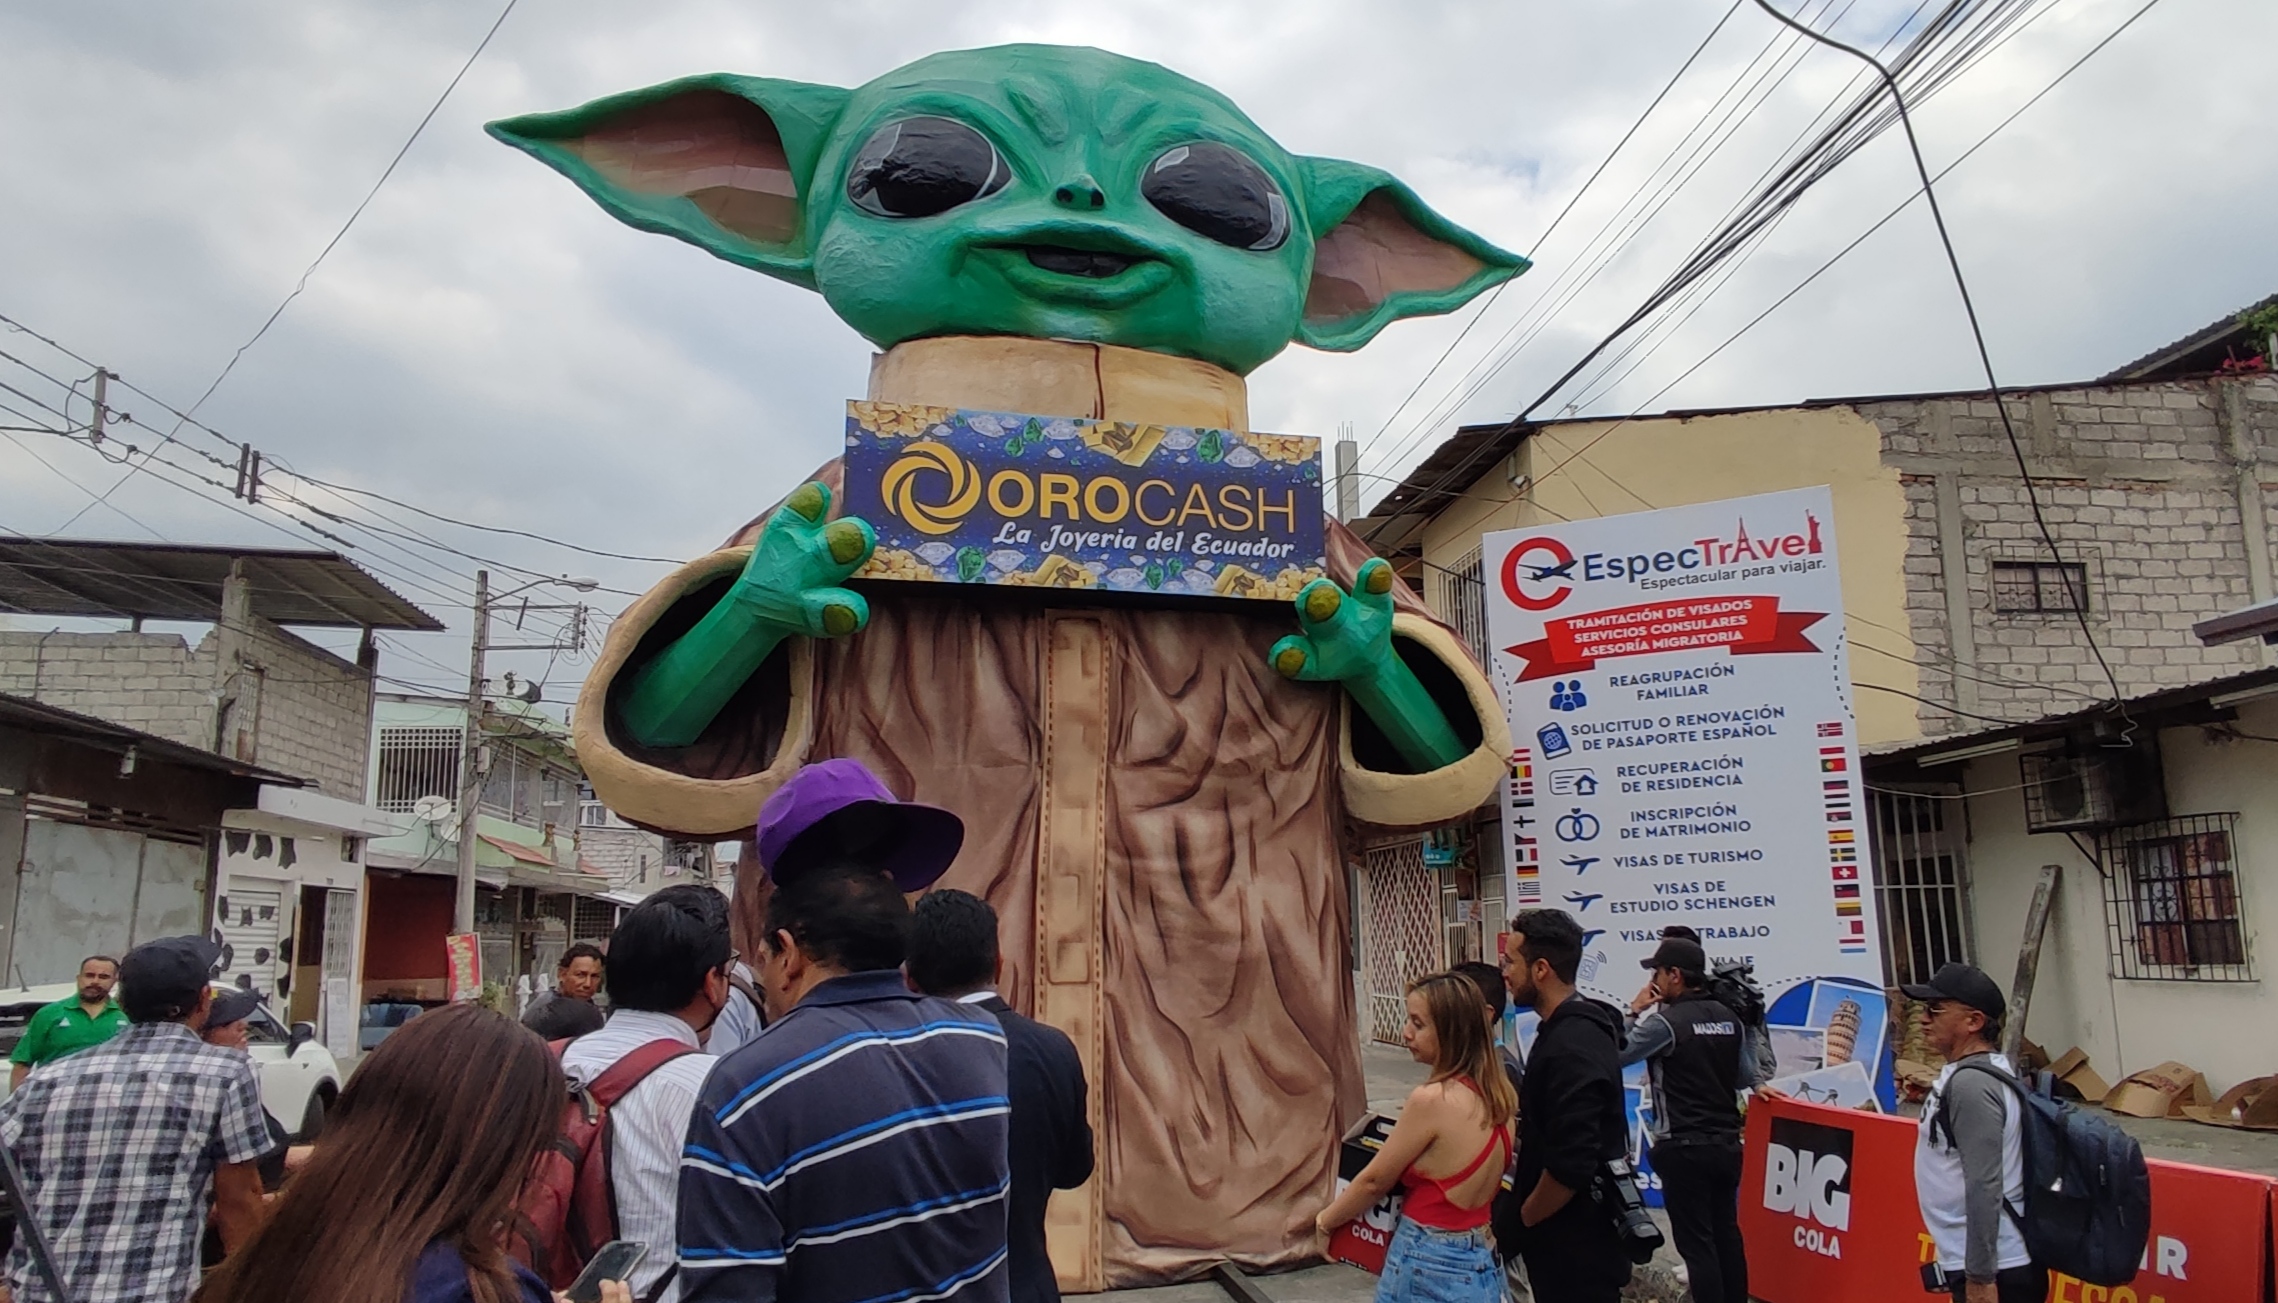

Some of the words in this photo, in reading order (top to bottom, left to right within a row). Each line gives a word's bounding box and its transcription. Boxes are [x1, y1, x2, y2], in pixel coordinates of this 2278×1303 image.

[987, 469, 1295, 534] OROCASH
[992, 521, 1032, 545] La
[1040, 524, 1138, 553] Joyeria
[1145, 530, 1183, 553] del
[1191, 532, 1296, 559] Ecuador
[1640, 568, 1737, 590] Espectacular
[1741, 564, 1776, 582] para
[1780, 557, 1827, 576] viajar.
[1566, 608, 1663, 630] TRAMITACIÓN
[1667, 606, 1686, 618] DE
[1688, 599, 1753, 616] VISADOS
[1574, 626, 1648, 644] SERVICIOS
[1650, 614, 1748, 635] CONSULARES
[1581, 638, 1650, 657] ASESORÍA
[1652, 630, 1744, 649] MIGRATORIA
[1609, 662, 1735, 688] REAGRUPACIÓN
[1637, 683, 1710, 701] FAMILIAR
[1571, 717, 1654, 736] SOLICITUD
[1658, 716, 1671, 728] O
[1676, 704, 1785, 727] RENOVACIÓN
[1582, 738, 1602, 751] DE
[1606, 730, 1698, 749] PASAPORTE
[1703, 722, 1778, 741] ESPAÑOL
[1617, 754, 1744, 777] RECUPERACIÓN
[1621, 781, 1642, 793] DE
[1646, 774, 1743, 792] RESIDENCIA
[1630, 802, 1738, 822] INSCRIPCIÓN
[1620, 827, 1641, 839] DE
[1645, 820, 1752, 838] MATRIMONIO
[1613, 855, 1659, 868] VISAS
[1663, 853, 1685, 866] DE
[1688, 849, 1764, 864] TURISMO
[1653, 881, 1700, 895] VISAS
[1704, 880, 1726, 893] DE
[1610, 900, 1679, 914] ESTUDIO
[1684, 895, 1776, 910] SCHENGEN
[1694, 925, 1770, 939] TRABAJO
[1763, 1142, 1851, 1232] BIG
[1352, 1224, 1385, 1247] COLA
[1793, 1225, 1842, 1260] COLA
